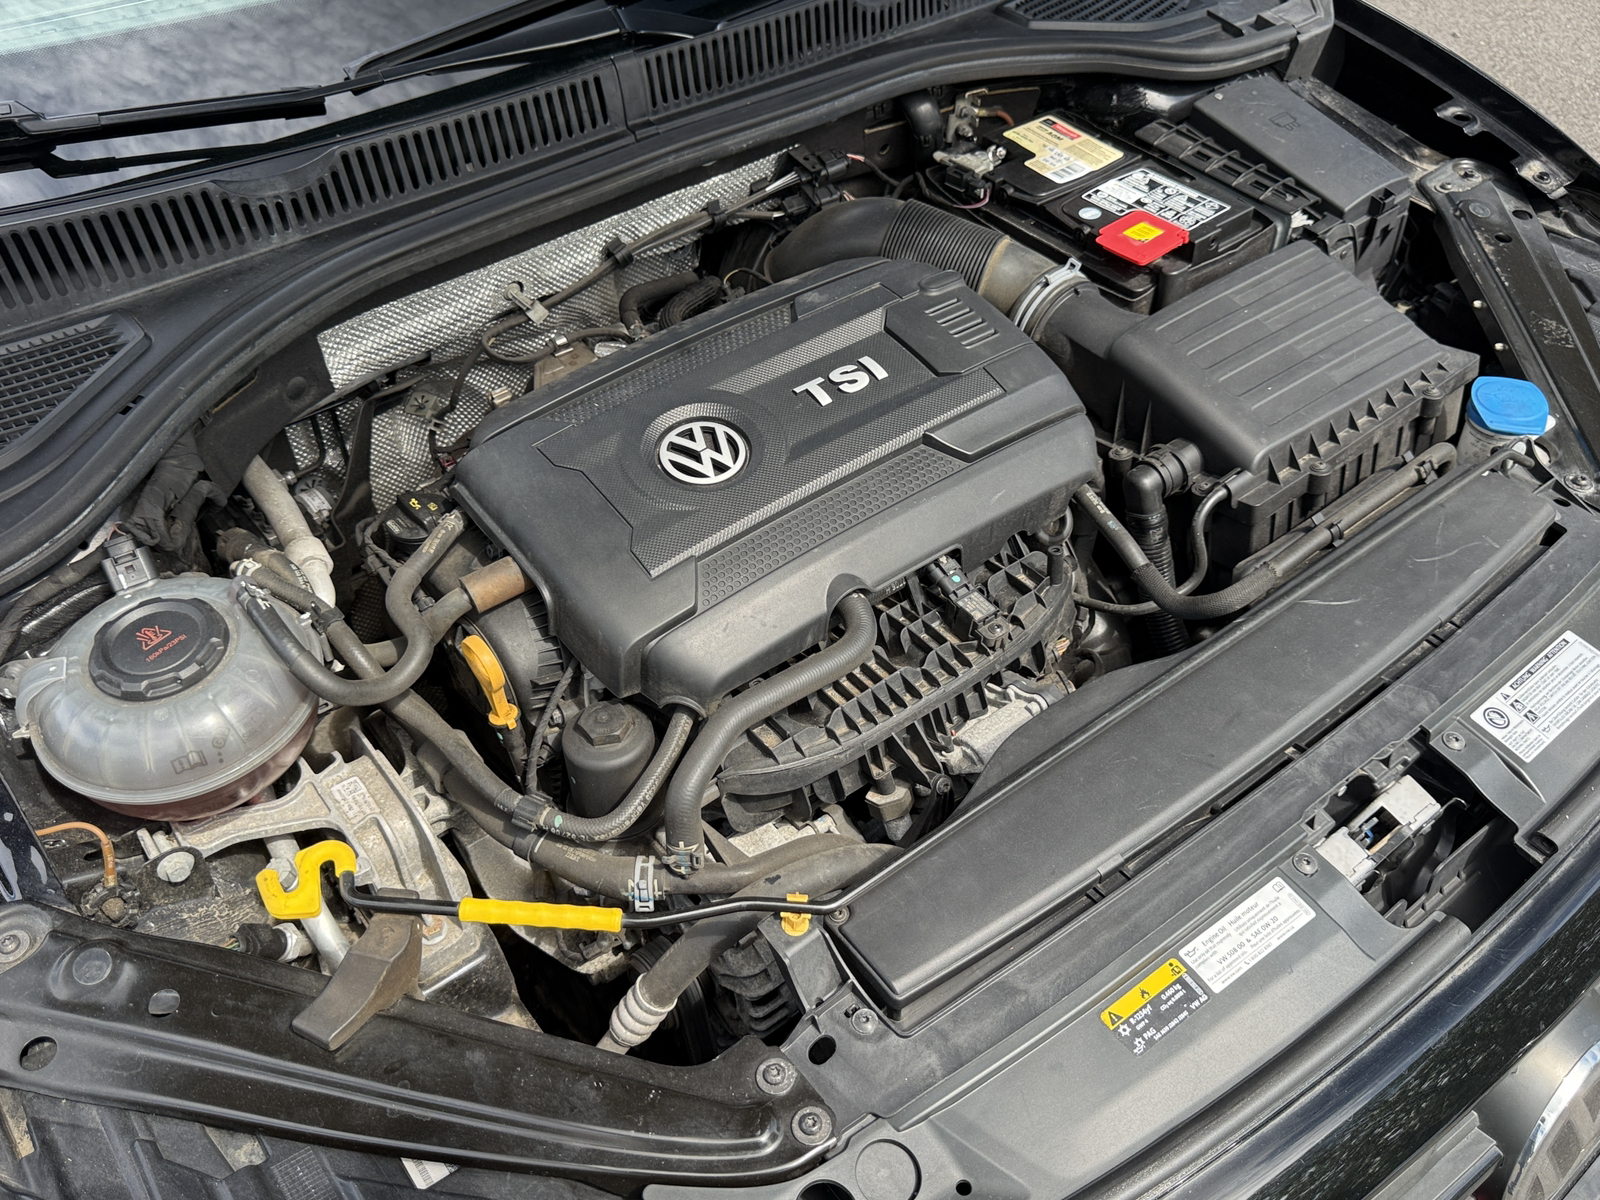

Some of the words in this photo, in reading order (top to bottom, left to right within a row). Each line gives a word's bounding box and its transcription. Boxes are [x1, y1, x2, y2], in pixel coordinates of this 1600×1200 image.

[792, 355, 889, 407] TSI
[659, 421, 746, 484] VW
[1227, 913, 1242, 926] Huile
[1240, 901, 1259, 917] moteur
[1200, 931, 1219, 947] Engine
[1217, 925, 1227, 934] Oil
[1216, 954, 1228, 965] VW
[1226, 947, 1238, 957] 508
[1236, 941, 1246, 949] 00
[1250, 928, 1262, 938] SAE
[1189, 999, 1201, 1010] VW
[1197, 993, 1208, 1003] AG
[1128, 1003, 1153, 1025] R-1234yf
[1142, 1026, 1157, 1040] PAG
